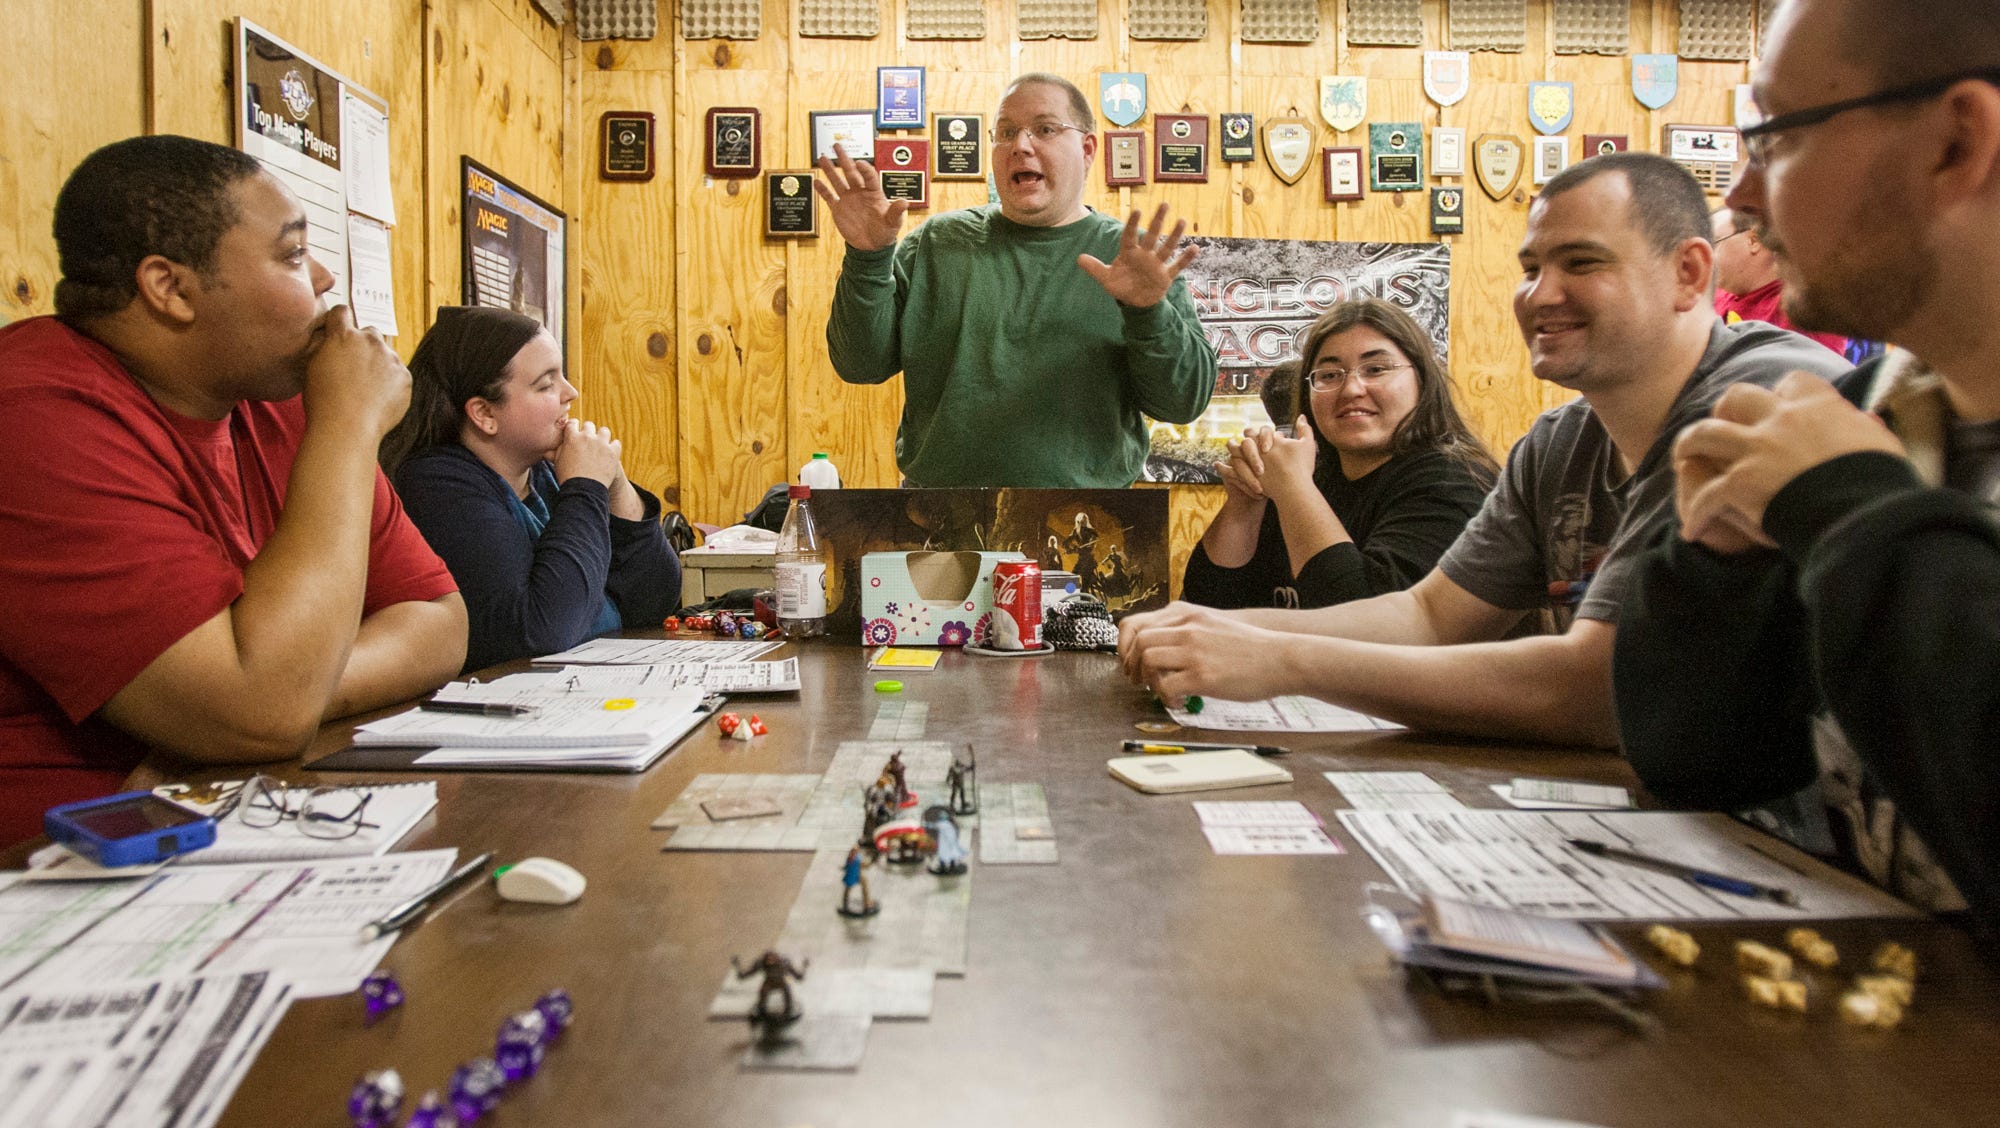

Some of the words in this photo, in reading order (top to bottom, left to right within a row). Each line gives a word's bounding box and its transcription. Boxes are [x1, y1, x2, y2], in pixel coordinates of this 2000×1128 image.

[253, 102, 272, 132] Top
[274, 113, 304, 144] Magic
[304, 128, 337, 161] Players
[476, 207, 509, 231] MAGIC
[1186, 272, 1425, 316] NGEONS
